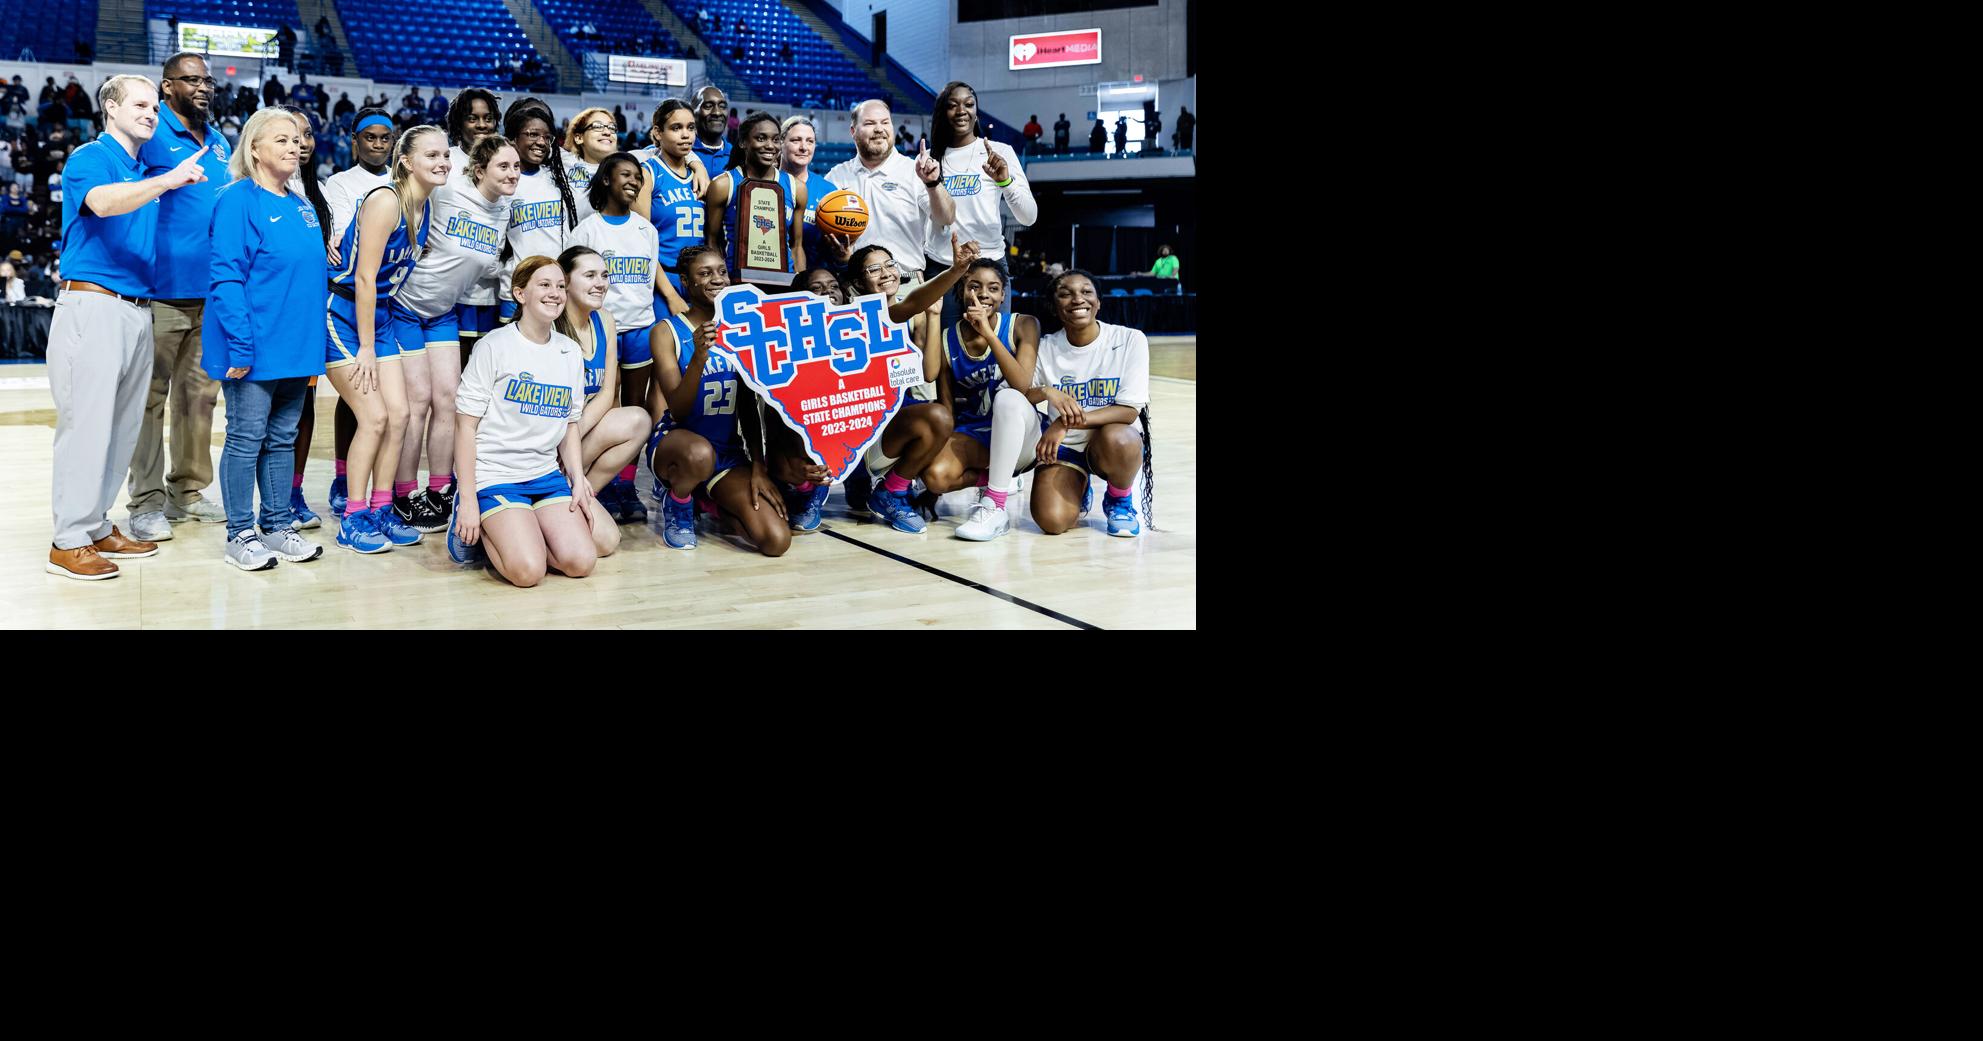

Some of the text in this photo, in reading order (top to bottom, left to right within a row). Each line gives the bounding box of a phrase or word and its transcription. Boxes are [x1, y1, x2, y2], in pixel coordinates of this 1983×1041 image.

[951, 175, 978, 189] VIEW
[659, 188, 691, 206] LAKE
[511, 200, 561, 226] LAKE VIEW
[676, 206, 704, 237] 22
[753, 215, 775, 229] SCHSL
[835, 215, 866, 228] Wilson
[446, 217, 498, 246] LAKE VIEW
[460, 238, 475, 250] WILD
[624, 258, 649, 275] VIEW
[611, 275, 623, 284] WILD
[721, 289, 906, 387] SCHSL
[890, 367, 916, 379] absolute
[891, 375, 920, 387] total care
[838, 378, 845, 390] A
[1088, 379, 1118, 397] VIEW
[506, 381, 571, 407] LAKE VIEW
[703, 380, 738, 416] 23
[801, 385, 885, 411] GIRLS BASKETBALL
[521, 402, 563, 416] WILD GATORS
[803, 399, 886, 426] STATE CHAMPIONS
[821, 416, 873, 436] 2023-2024
